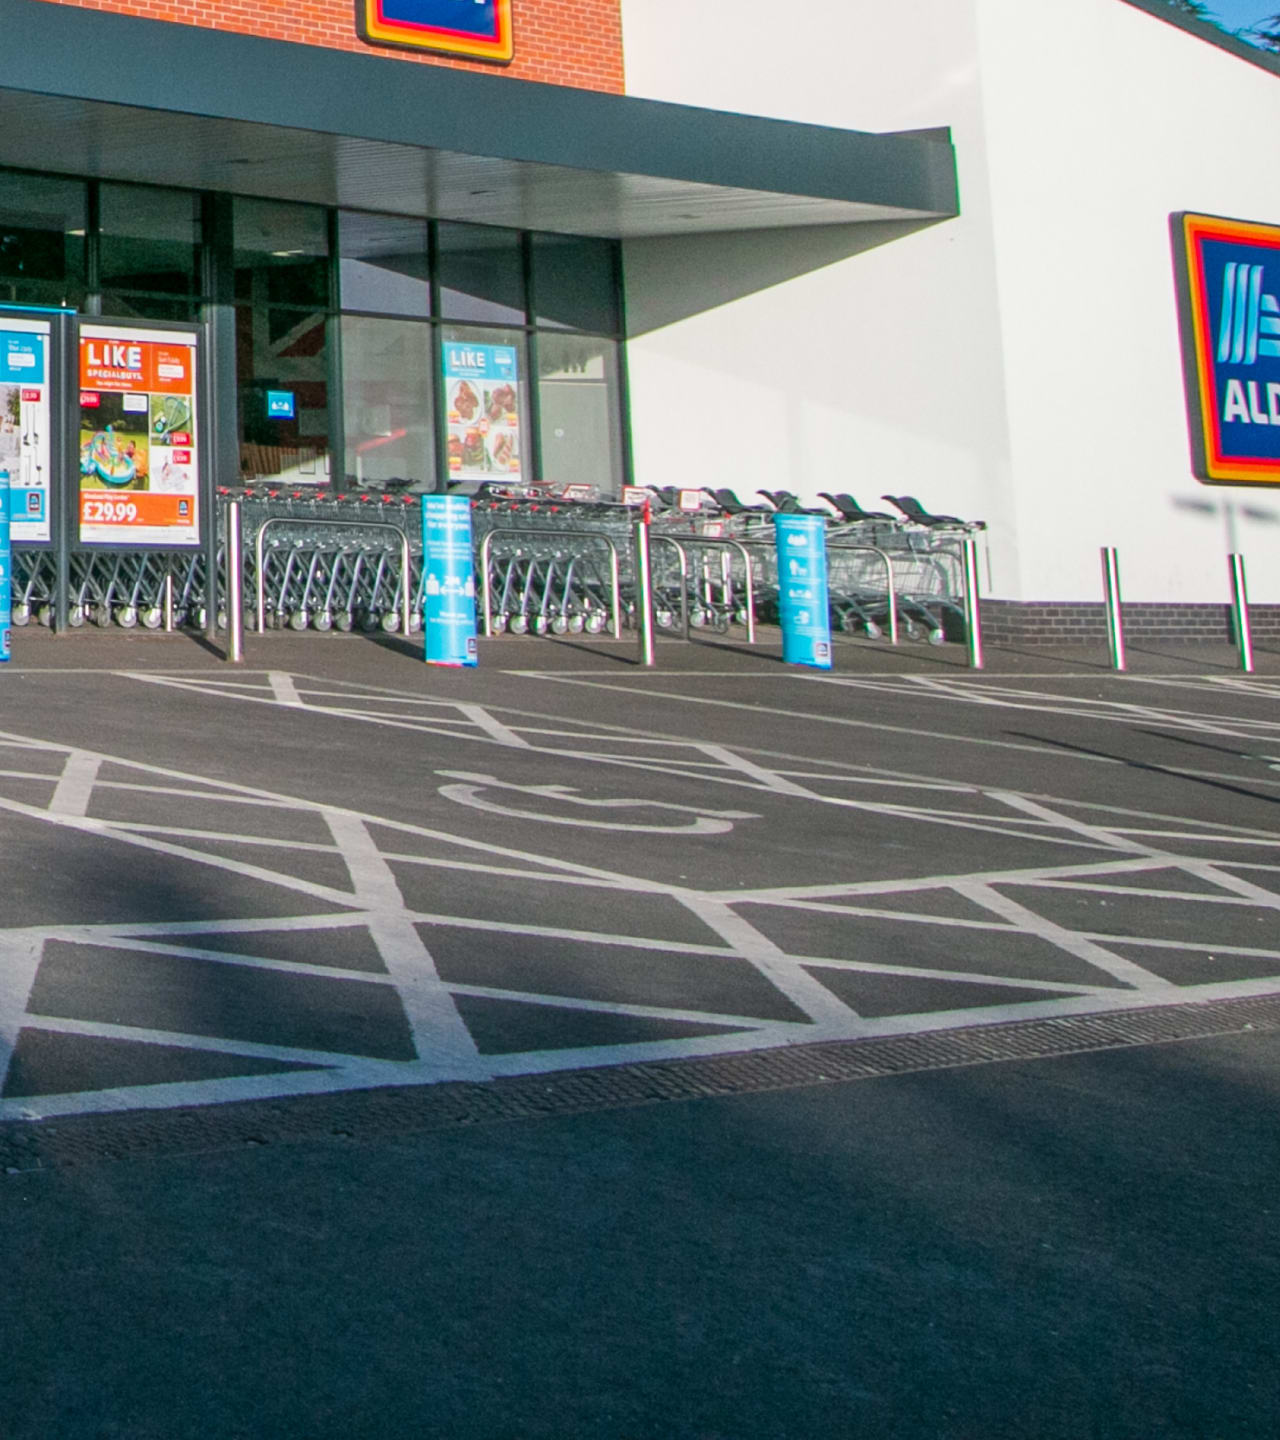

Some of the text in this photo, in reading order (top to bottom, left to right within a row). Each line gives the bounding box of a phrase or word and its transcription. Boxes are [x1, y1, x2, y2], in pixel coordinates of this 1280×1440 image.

[86, 343, 143, 370] LIKE
[450, 349, 486, 368] LIKE
[1223, 378, 1280, 426] ALD
[83, 501, 138, 523] £29.99
